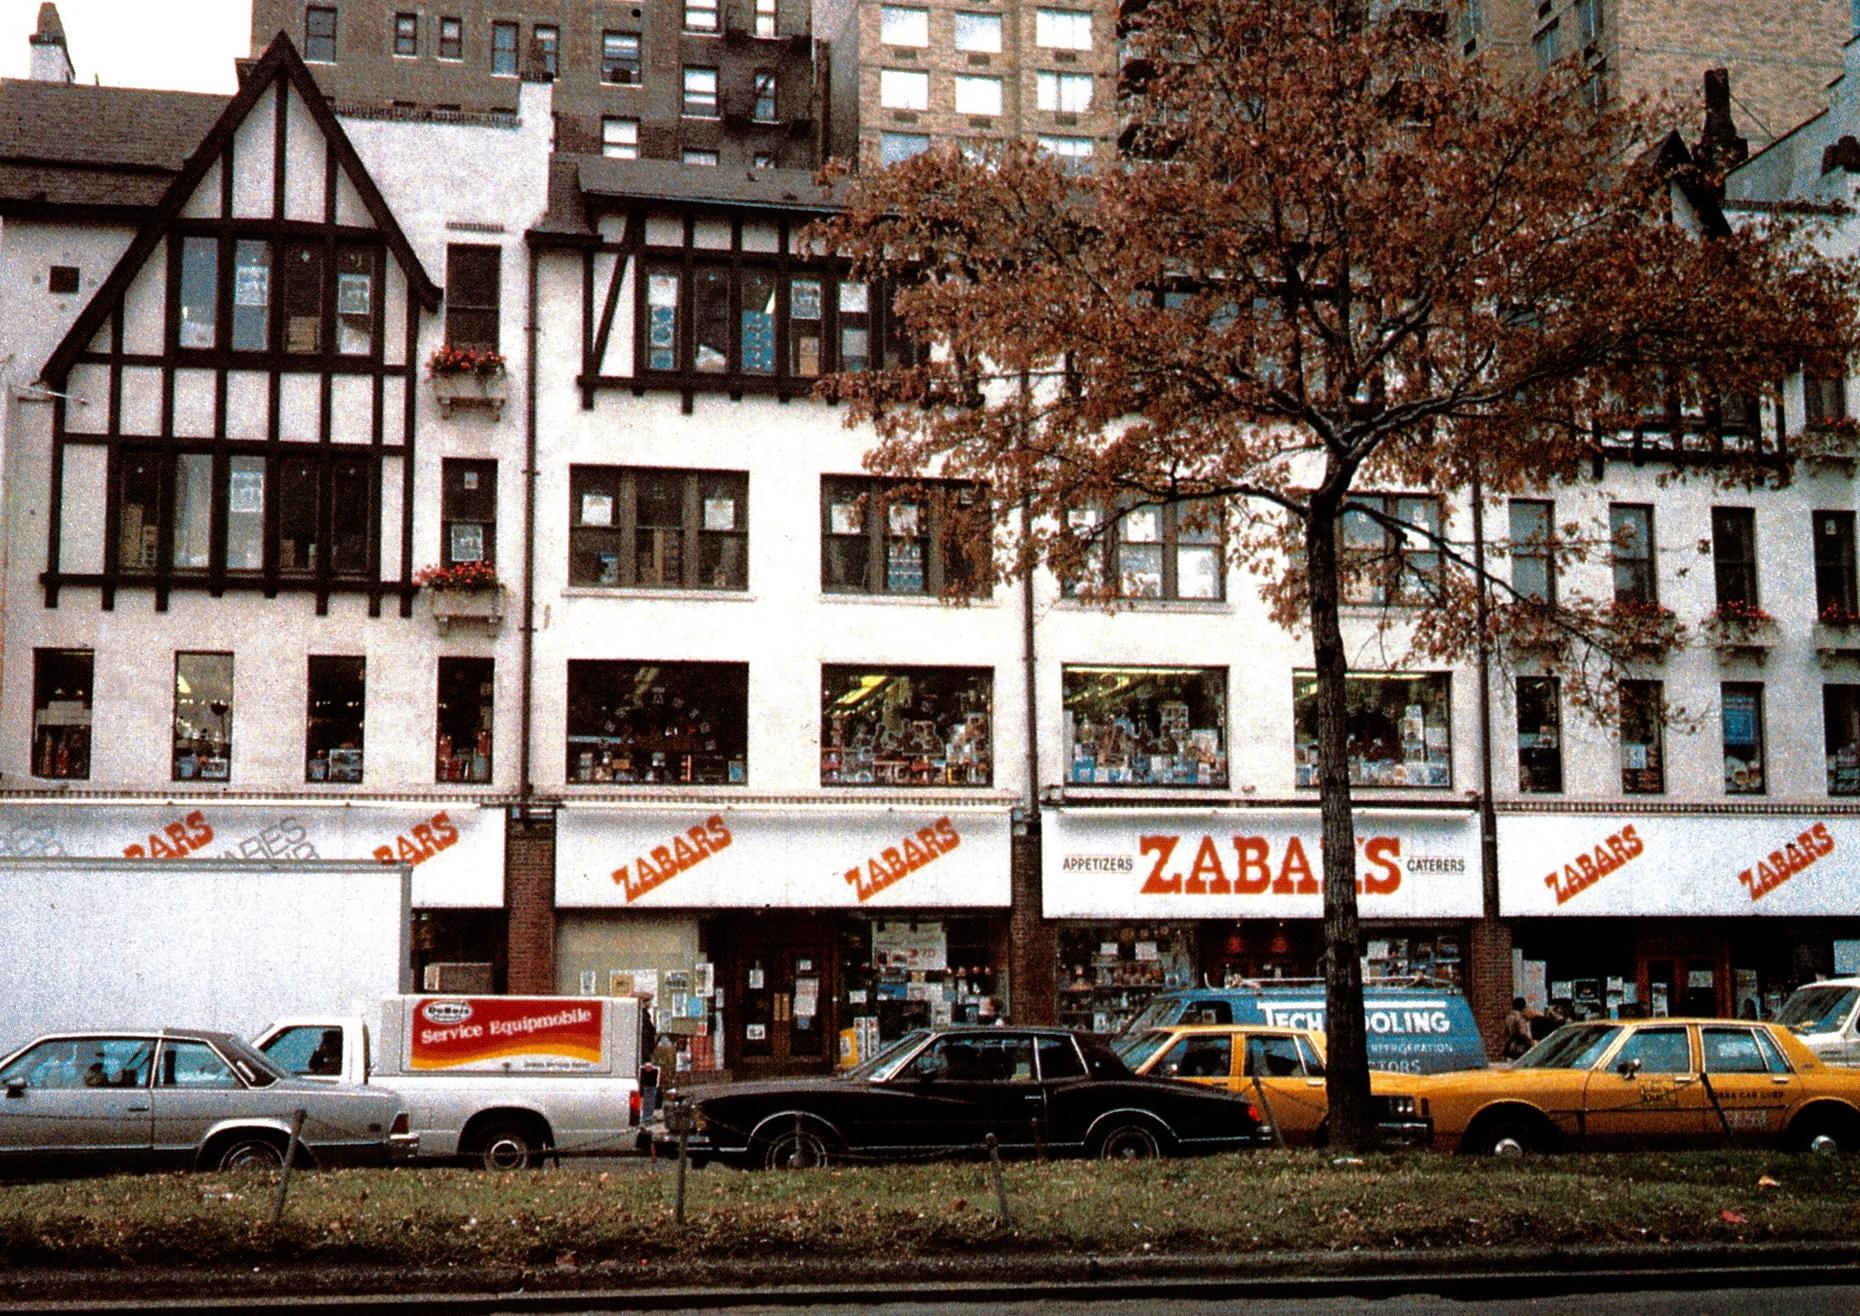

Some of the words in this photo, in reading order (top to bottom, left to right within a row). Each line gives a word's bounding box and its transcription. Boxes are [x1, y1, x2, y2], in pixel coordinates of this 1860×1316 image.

[1063, 857, 1133, 871] APPETIZERS
[1139, 835, 1402, 895] ZABA'S
[1407, 858, 1465, 872] CATERERS
[421, 1023, 483, 1044] Service
[489, 1007, 592, 1036] Equipmobile
